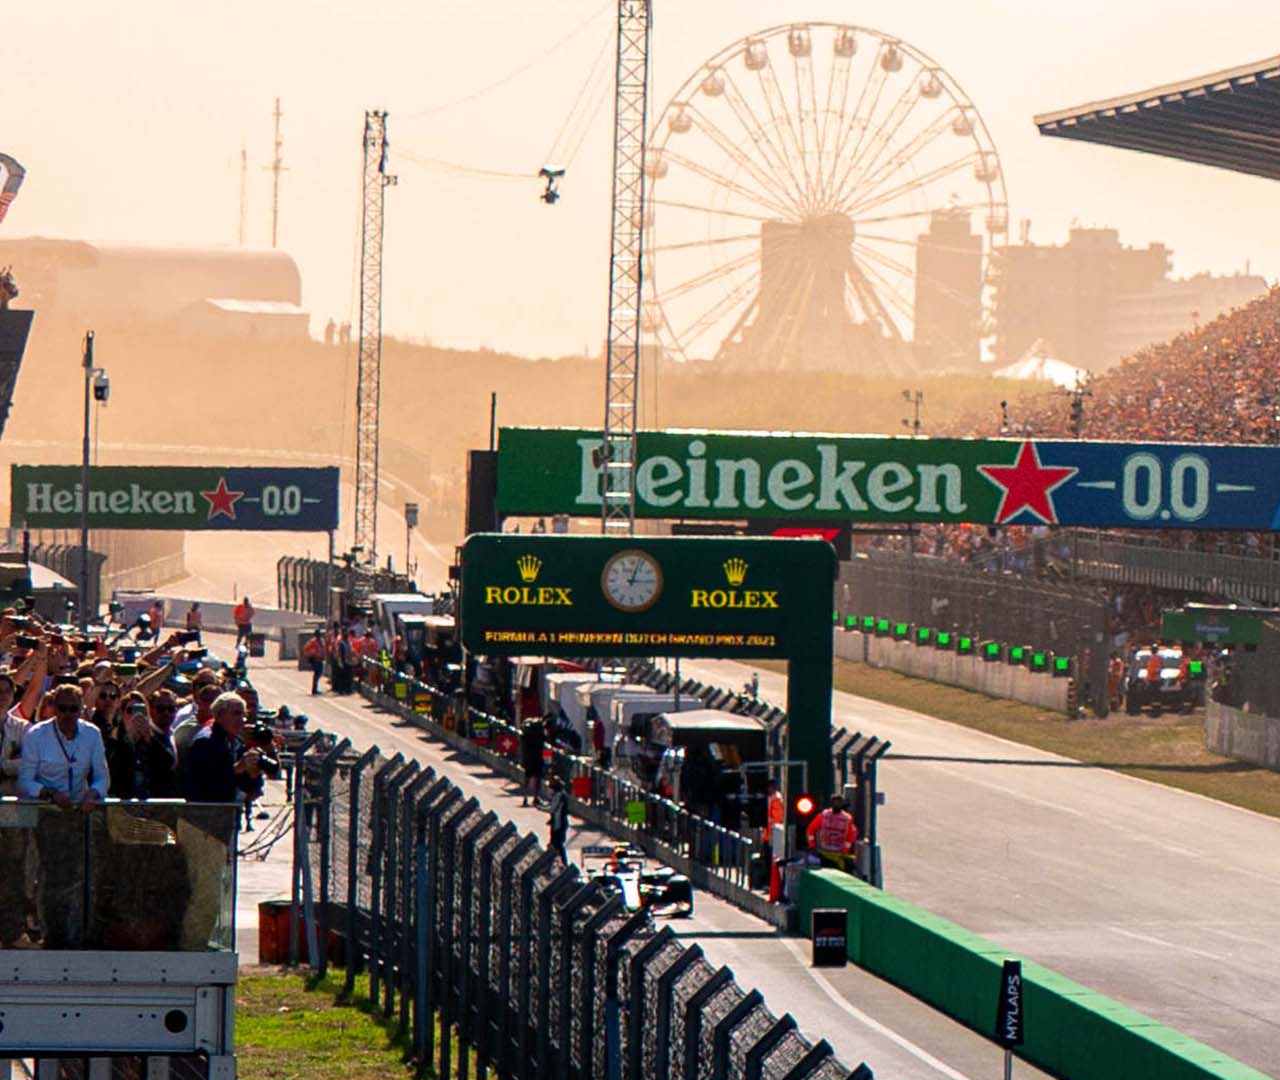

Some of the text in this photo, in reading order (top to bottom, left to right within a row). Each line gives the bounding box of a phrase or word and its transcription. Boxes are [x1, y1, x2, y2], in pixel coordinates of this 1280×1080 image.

[575, 437, 1210, 520] Heineken 0.0
[26, 483, 301, 516] Heineken 0.0
[485, 586, 573, 605] ROLEX
[690, 589, 779, 609] ROLEX
[485, 631, 547, 643] FORMULA
[558, 632, 623, 644] HEINEKEN
[625, 633, 667, 644] DUTCH
[1006, 974, 1021, 1040] MYLAPS
